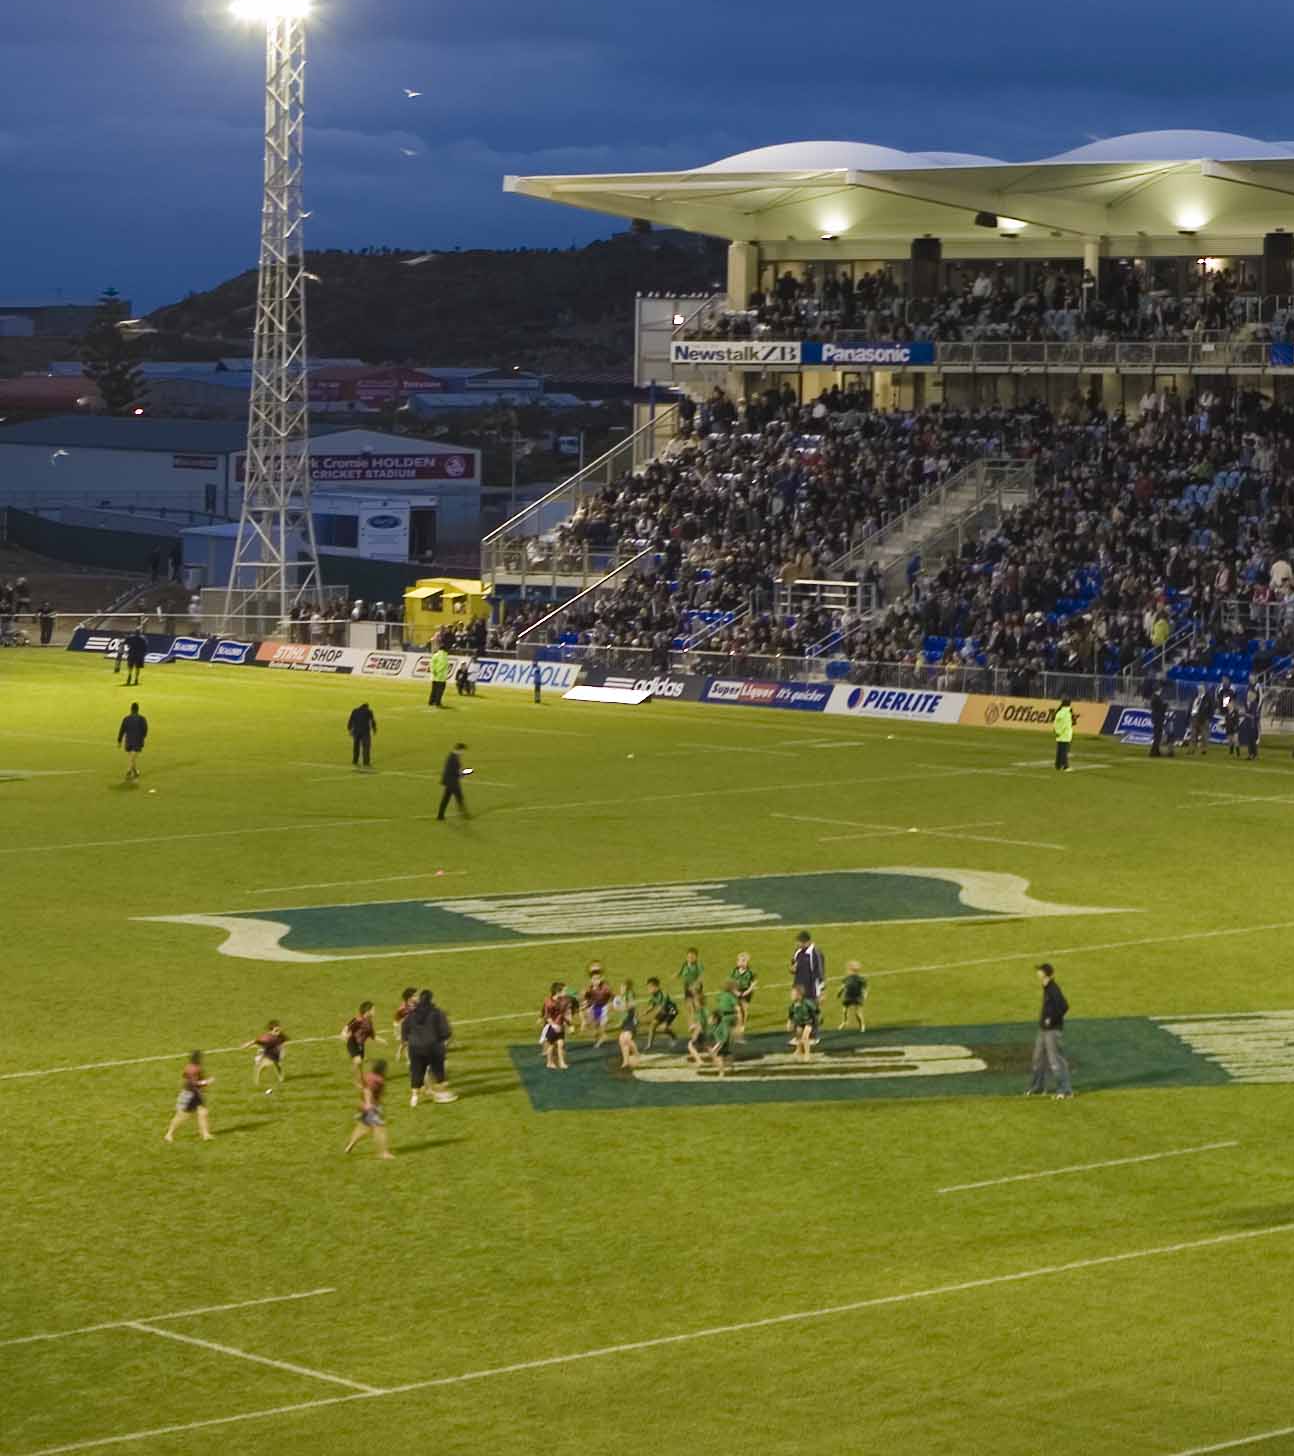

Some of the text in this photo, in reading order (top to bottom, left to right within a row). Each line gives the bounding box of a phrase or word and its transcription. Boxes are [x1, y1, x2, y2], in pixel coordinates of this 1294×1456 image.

[821, 343, 910, 362] Panasonic
[371, 456, 435, 469] HOLDEN
[312, 469, 416, 479] CRICKET STADIUM
[311, 648, 343, 662] SHOP
[633, 676, 685, 697] adidas
[864, 690, 943, 714] PIERLITE
[1003, 704, 1081, 726] OfficeMx
[1122, 714, 1153, 730] SEALO
